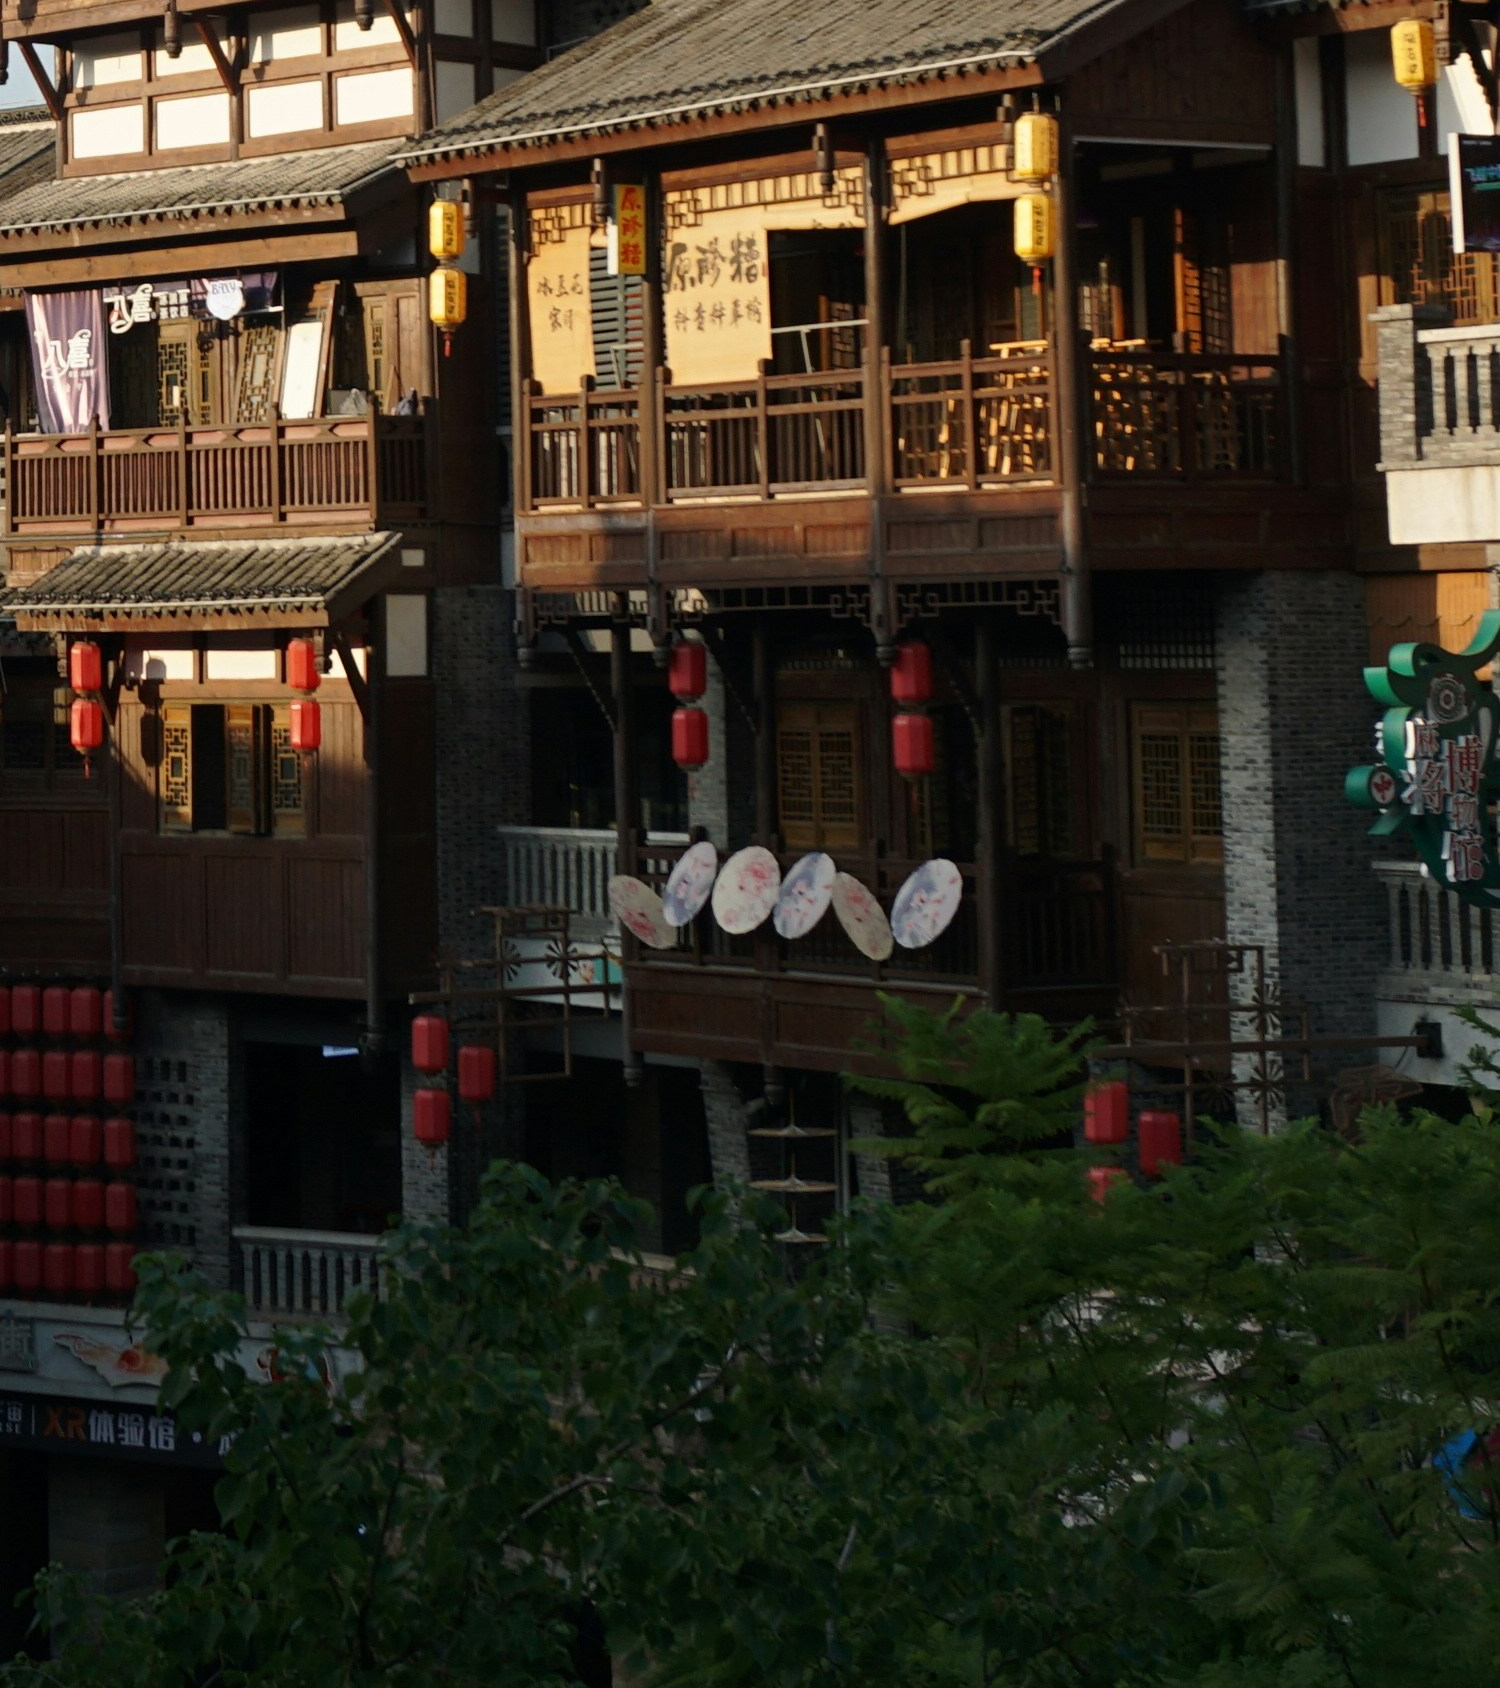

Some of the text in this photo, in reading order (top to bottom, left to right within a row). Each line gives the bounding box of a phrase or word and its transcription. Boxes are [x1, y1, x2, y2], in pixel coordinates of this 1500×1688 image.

[103, 283, 154, 334] 八喜
[42, 1402, 176, 1452] XR体验馆
